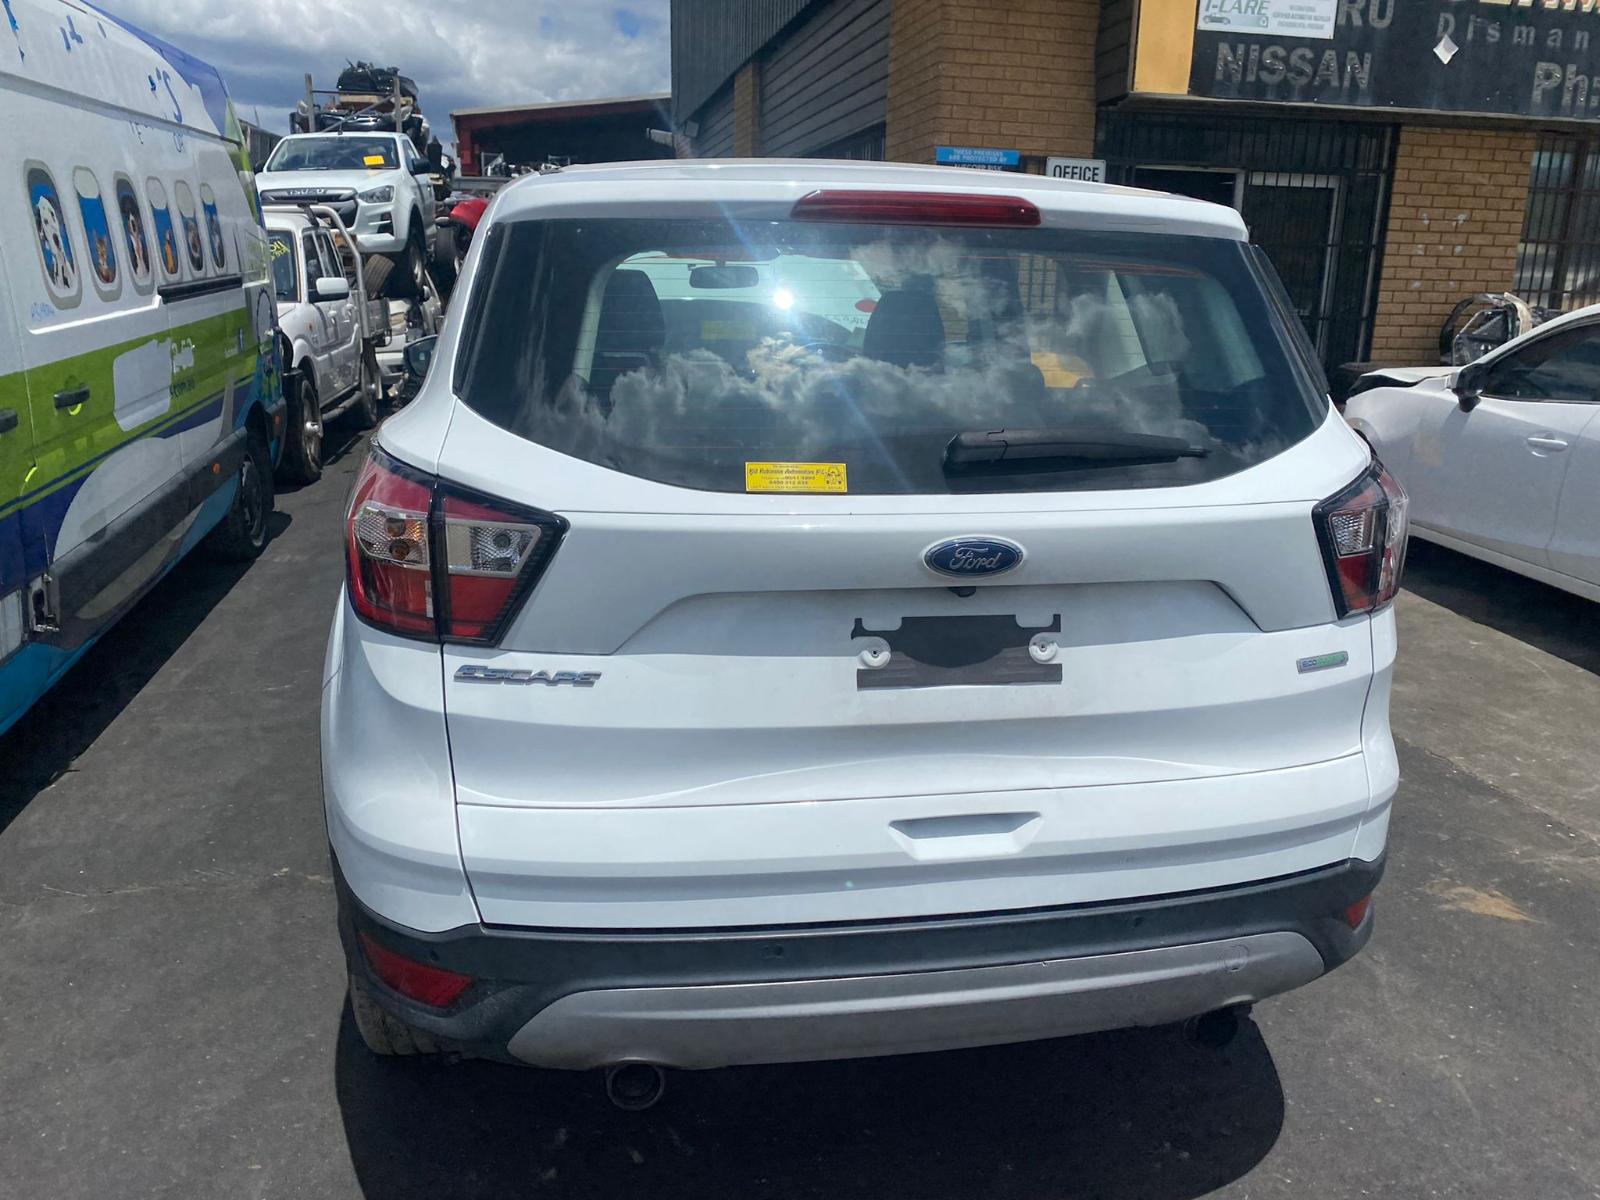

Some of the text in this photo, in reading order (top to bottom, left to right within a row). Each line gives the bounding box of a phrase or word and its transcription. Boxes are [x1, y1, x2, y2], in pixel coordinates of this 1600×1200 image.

[1215, 41, 1372, 90] NISSAN
[1053, 165, 1099, 183] OFFICE
[949, 547, 1002, 569] Ford
[454, 664, 602, 687] ESCAPE
